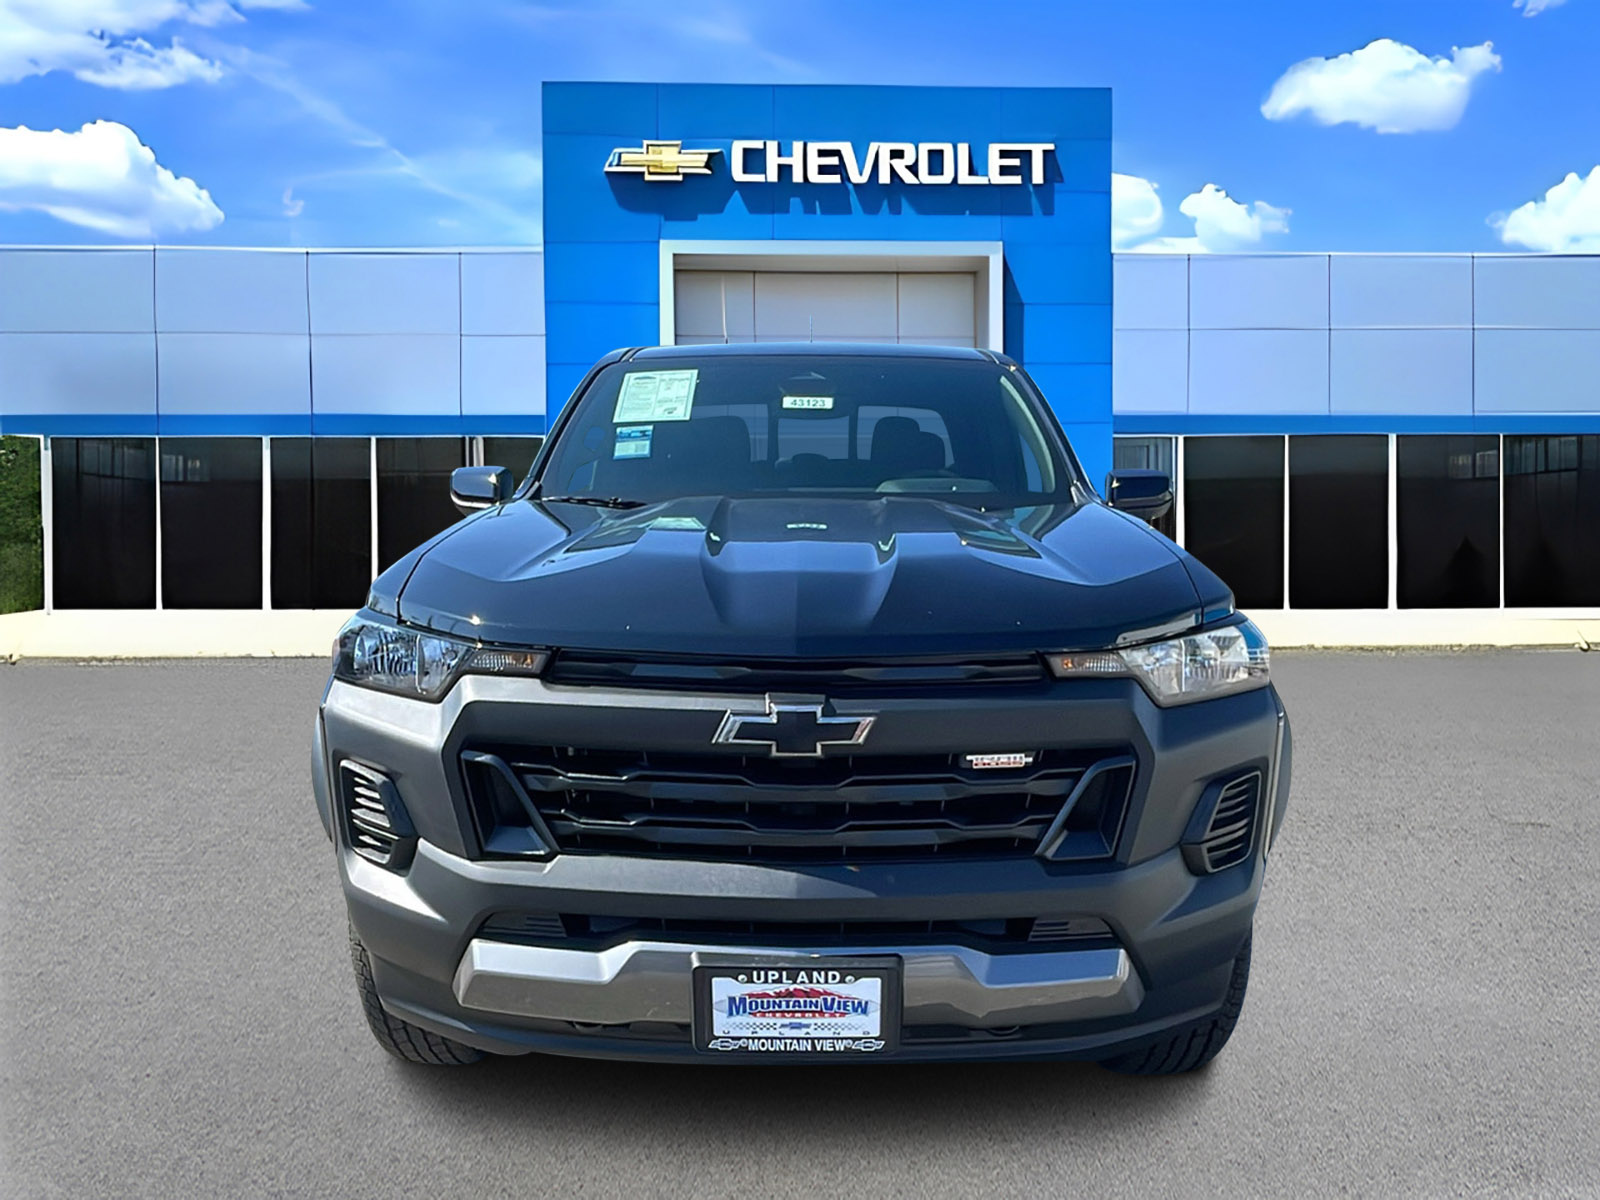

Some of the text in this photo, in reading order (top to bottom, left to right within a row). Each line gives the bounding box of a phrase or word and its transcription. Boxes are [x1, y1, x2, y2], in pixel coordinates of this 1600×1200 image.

[731, 140, 1055, 184] CHEVROLET
[790, 399, 826, 407] 43123
[753, 971, 841, 983] UPLAND
[748, 1039, 811, 1051] MOUNTAIN
[815, 1039, 846, 1051] VIEW
